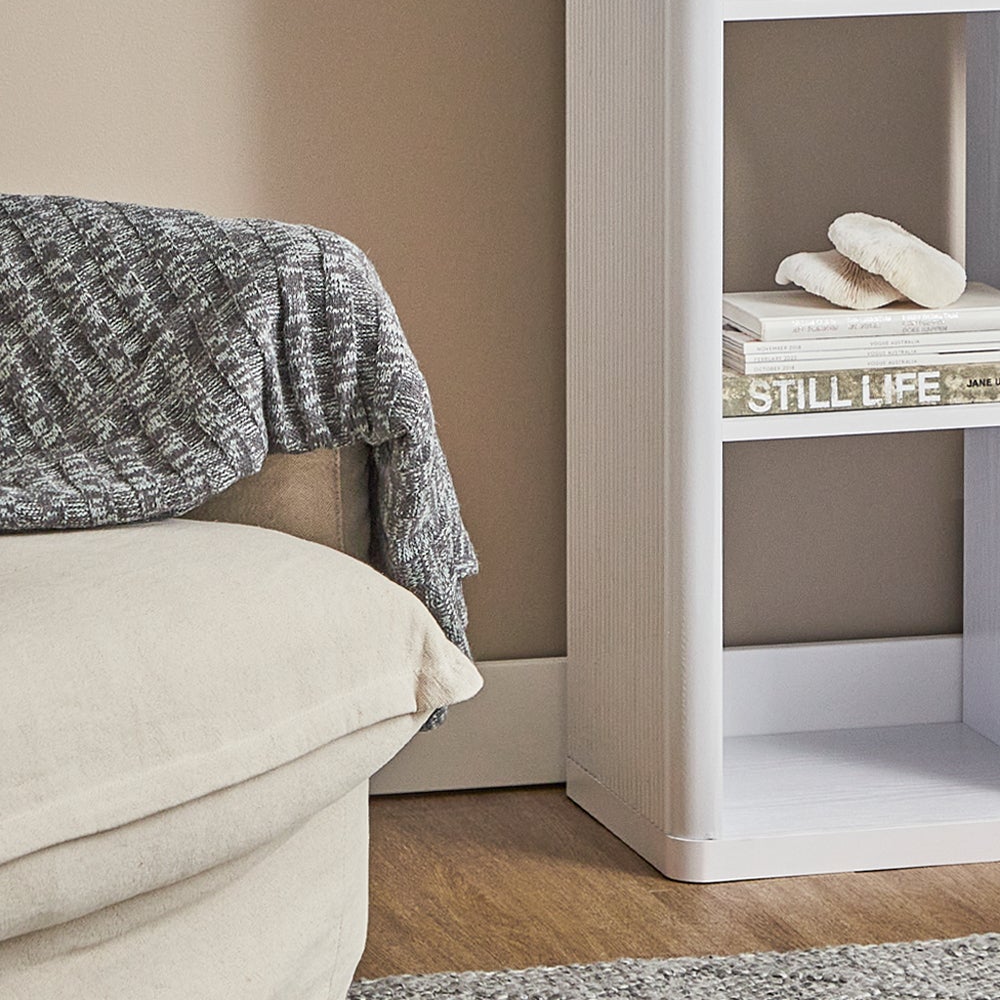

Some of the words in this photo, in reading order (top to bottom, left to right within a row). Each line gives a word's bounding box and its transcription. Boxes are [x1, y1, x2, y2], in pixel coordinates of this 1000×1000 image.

[748, 376, 853, 414] STILL
[862, 371, 940, 407] LIFE
[966, 378, 992, 389] JANE
